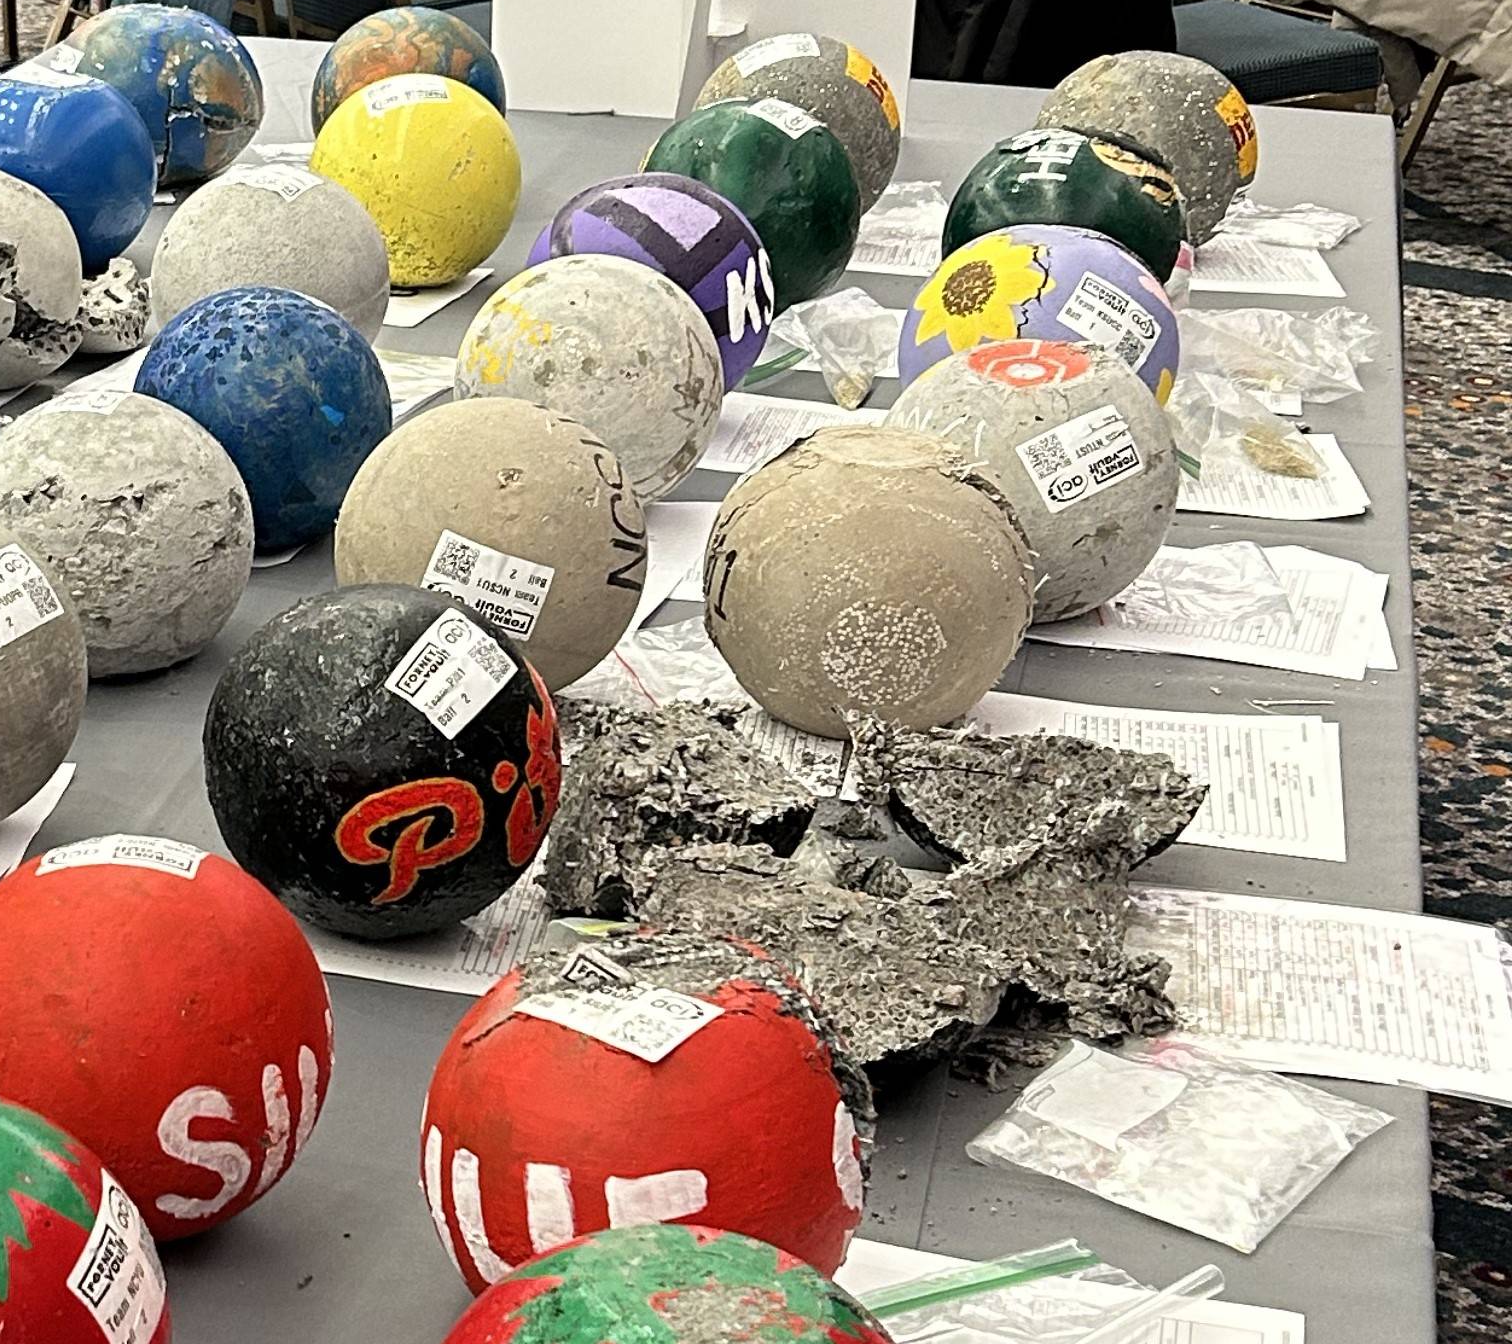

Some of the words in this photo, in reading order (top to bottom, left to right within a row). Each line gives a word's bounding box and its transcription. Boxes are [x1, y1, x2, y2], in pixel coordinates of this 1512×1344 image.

[1087, 451, 1121, 475] vault
[1099, 455, 1136, 475] FORNEY
[1058, 474, 1085, 497] aci
[475, 577, 511, 598] NCSU1
[526, 573, 547, 589] Ball
[474, 597, 513, 619] vault
[513, 588, 540, 606] Team
[401, 647, 439, 689] FORNEY
[436, 705, 458, 727] Ball
[103, 1296, 131, 1333] Team
